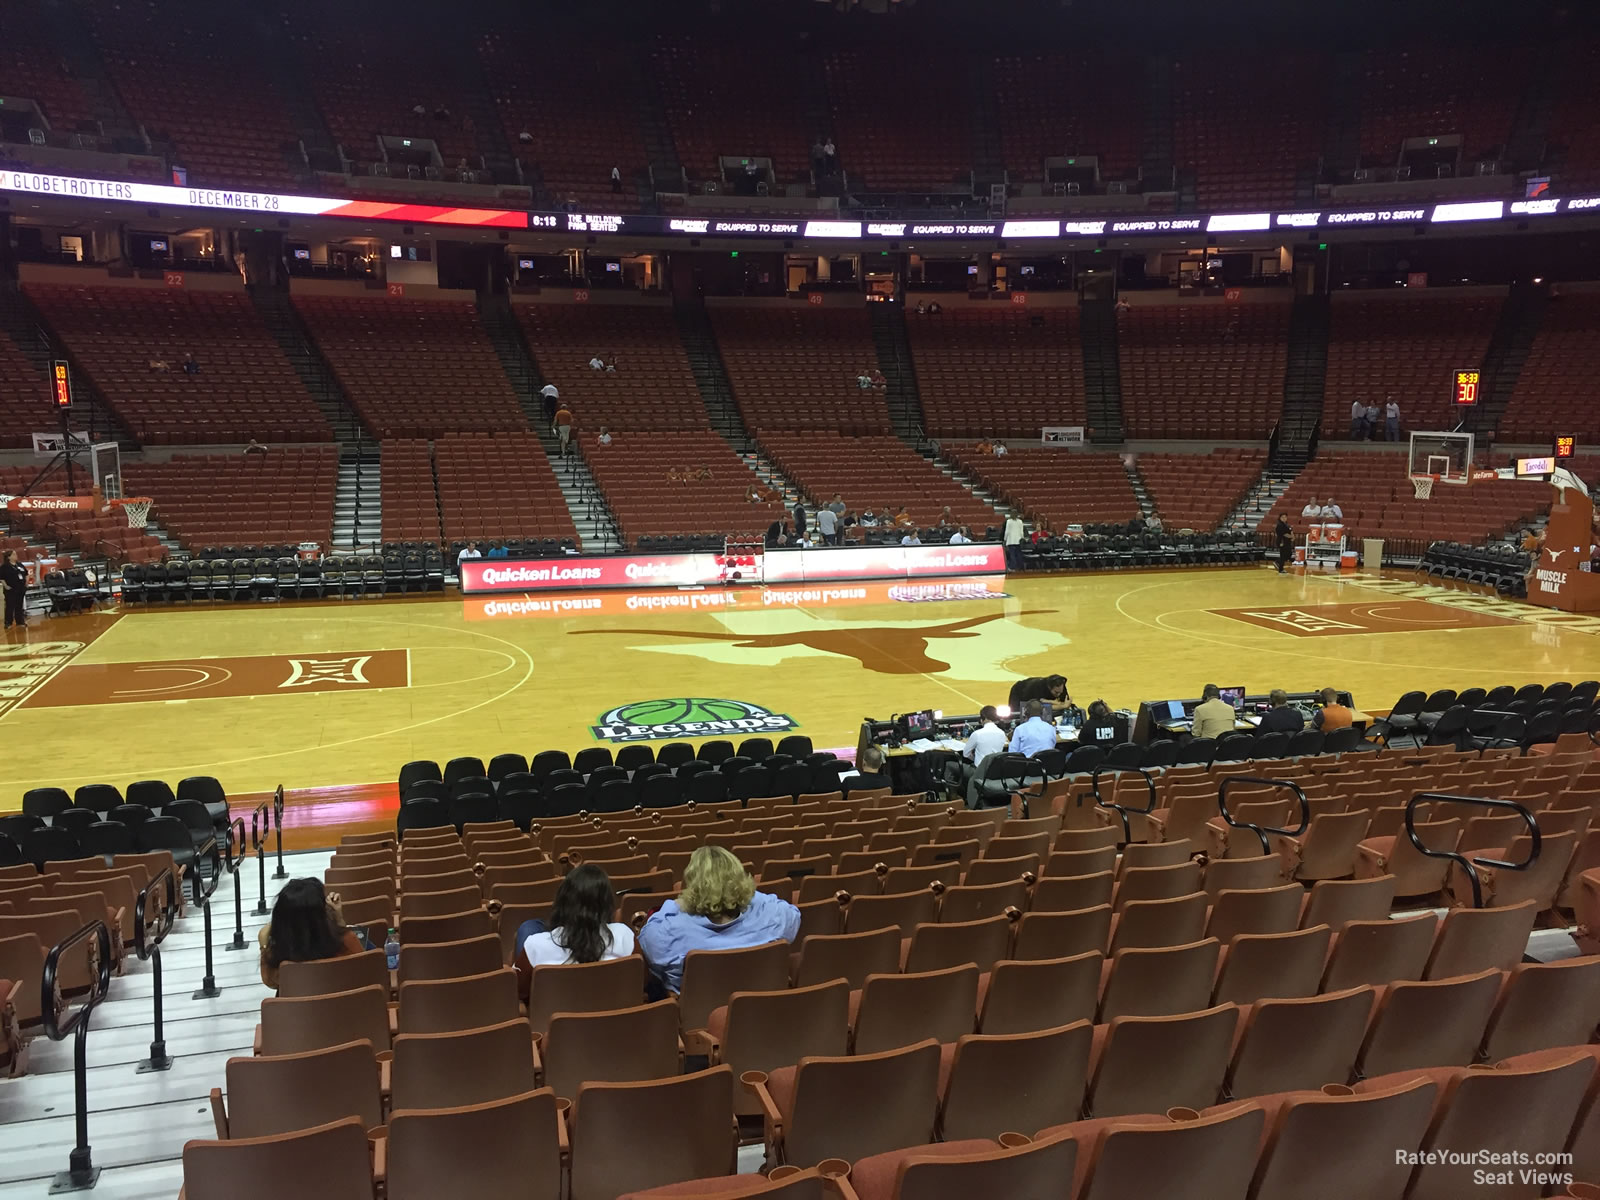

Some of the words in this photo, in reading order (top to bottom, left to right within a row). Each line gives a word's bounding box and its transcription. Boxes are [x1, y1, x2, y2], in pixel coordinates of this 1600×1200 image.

[13, 173, 133, 199] GLOBETROTTERS
[189, 190, 259, 208] DECEMBER
[263, 195, 279, 209] 28
[568, 214, 583, 223] THE
[1327, 212, 1376, 223] EQUIPPED
[1377, 211, 1392, 221] TO
[1392, 209, 1425, 220] SERVE
[715, 222, 758, 232] EQUIPPED
[758, 224, 771, 232] TO
[771, 224, 799, 233] SERVE
[912, 225, 955, 234] EQUIPPED
[955, 225, 968, 234] TO
[968, 225, 996, 234] SERVE
[1112, 222, 1157, 231] EQUIPPED
[1157, 221, 1171, 230] TO
[1171, 219, 1201, 229] SERVE
[167, 275, 183, 286] 22
[390, 285, 403, 295] 21
[576, 291, 588, 300] 20
[1226, 291, 1239, 300] 47
[1013, 295, 1025, 304] 48
[1457, 373, 1479, 384] 36:33
[1459, 384, 1475, 401] 30
[1559, 446, 1570, 455] 30
[945, 552, 988, 567] Loans
[482, 566, 551, 584] Quicken
[551, 565, 602, 580] Loans
[1536, 568, 1568, 584] MUSCLE
[1540, 580, 1561, 594] MILK
[598, 715, 791, 738] LEGENDS
